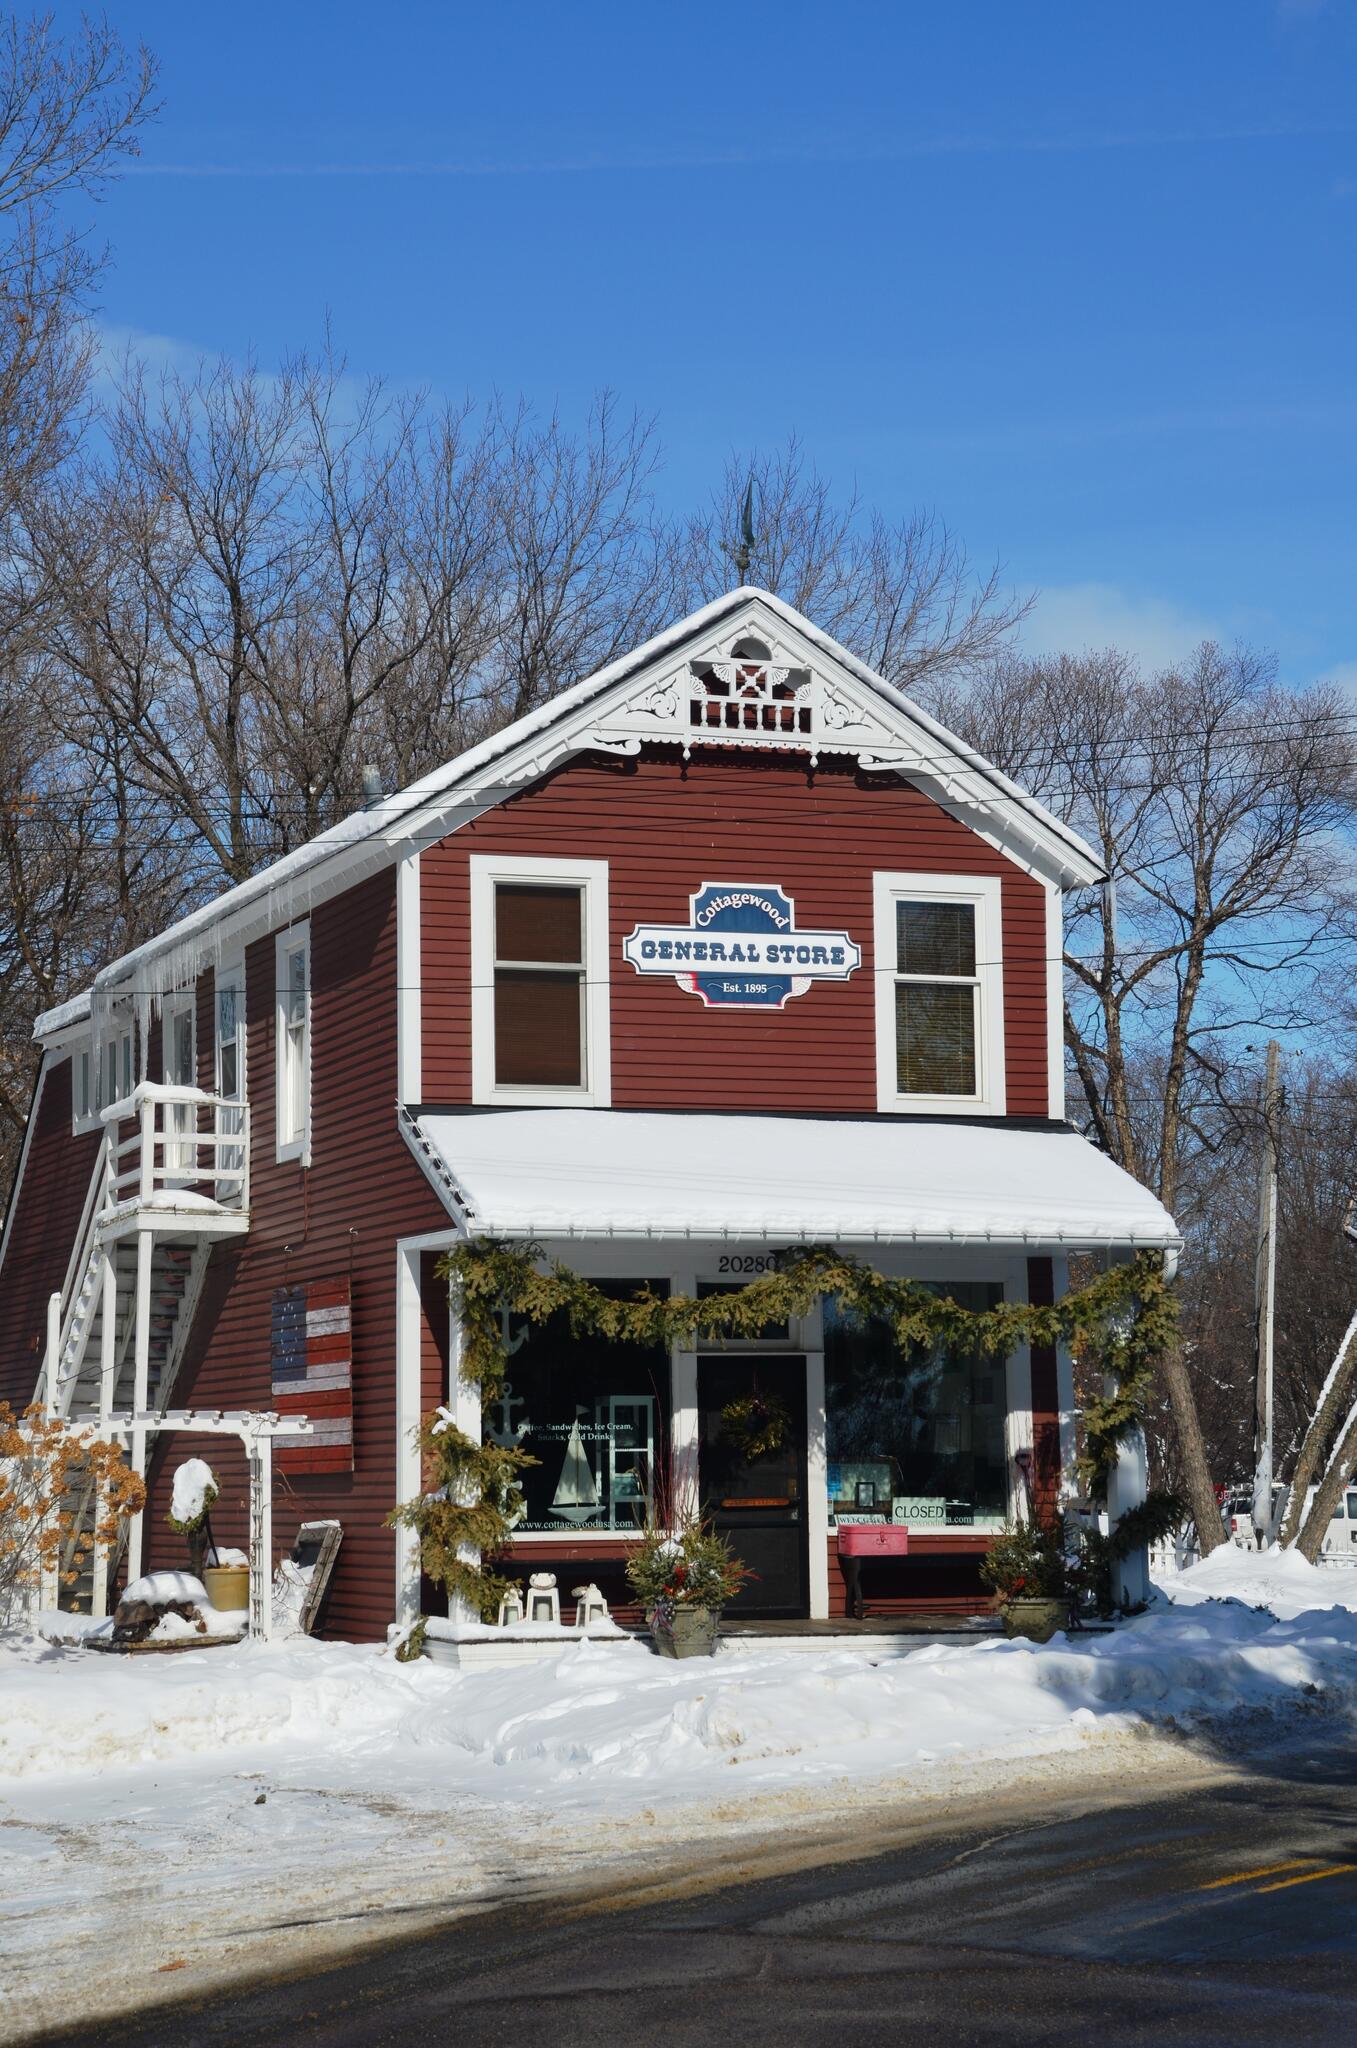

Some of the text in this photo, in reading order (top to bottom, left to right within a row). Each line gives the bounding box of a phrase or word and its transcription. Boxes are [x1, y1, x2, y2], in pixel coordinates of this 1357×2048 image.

[696, 892, 790, 929] Cottagewood
[641, 940, 845, 965] GENERAL STORE
[722, 982, 767, 994] Est. 1895
[594, 1422, 605, 1430] Ice
[606, 1422, 634, 1431] Cream,
[567, 1432, 586, 1440] Cld
[895, 1505, 944, 1518] CLOSED
[518, 1519, 634, 1529] www.cottagewoodusacom
